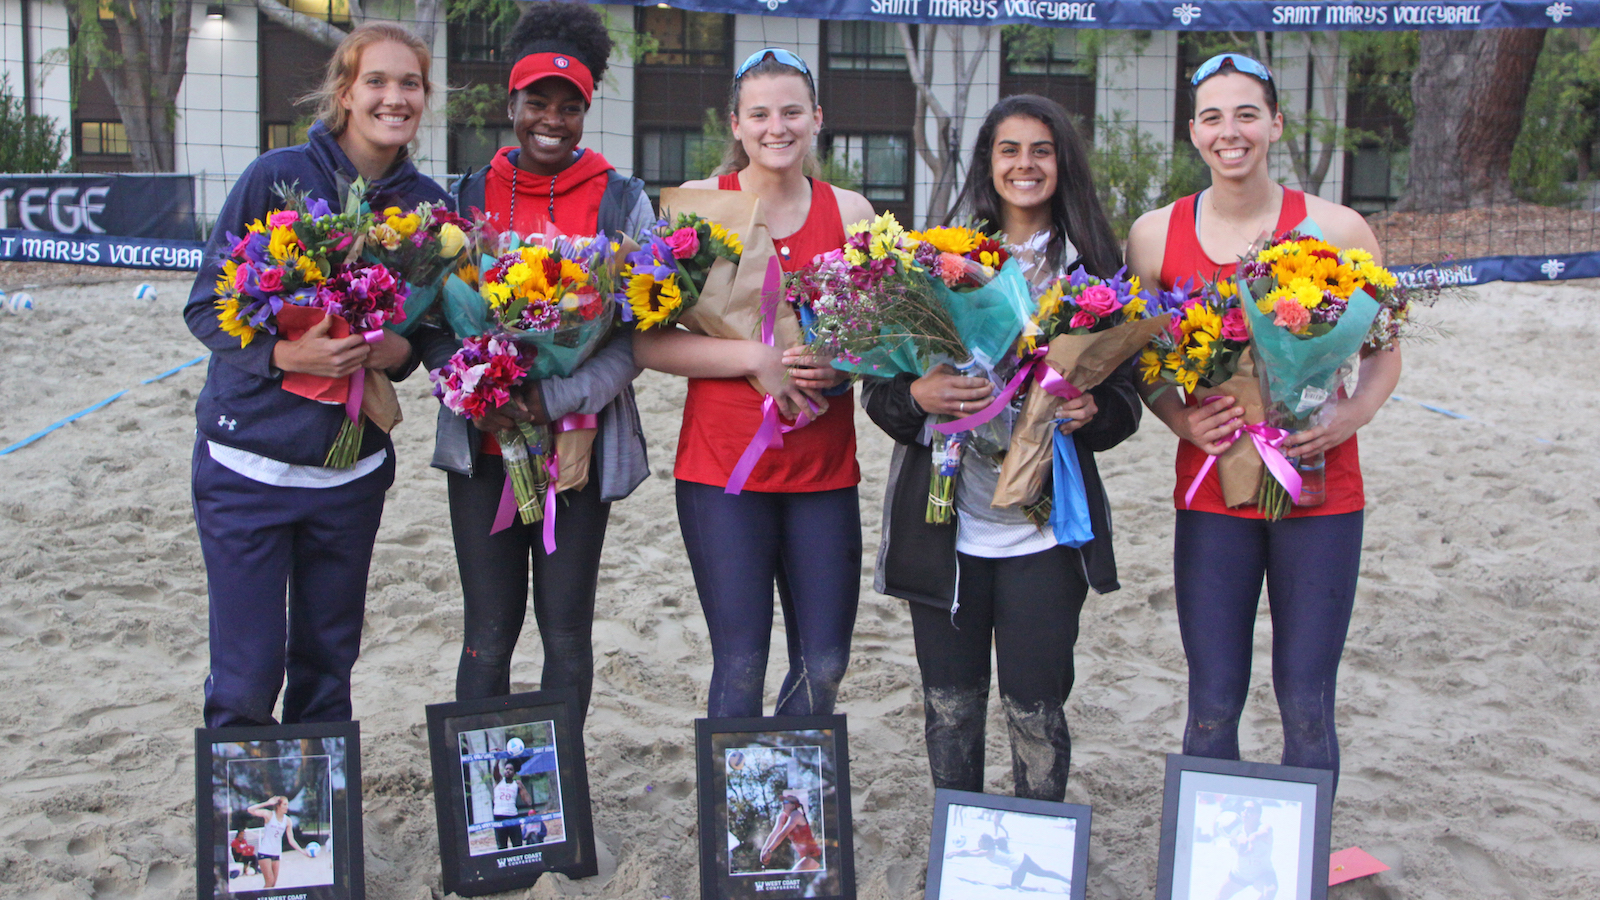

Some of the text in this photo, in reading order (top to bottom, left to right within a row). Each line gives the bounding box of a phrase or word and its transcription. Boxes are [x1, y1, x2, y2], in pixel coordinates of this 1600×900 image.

[871, 0, 919, 15] SAINT
[1004, 0, 1096, 21] VOLLEYBALL
[1272, 6, 1321, 24] SAINT
[1393, 6, 1480, 24] VOLLEYBALL
[524, 852, 542, 860] COAST
